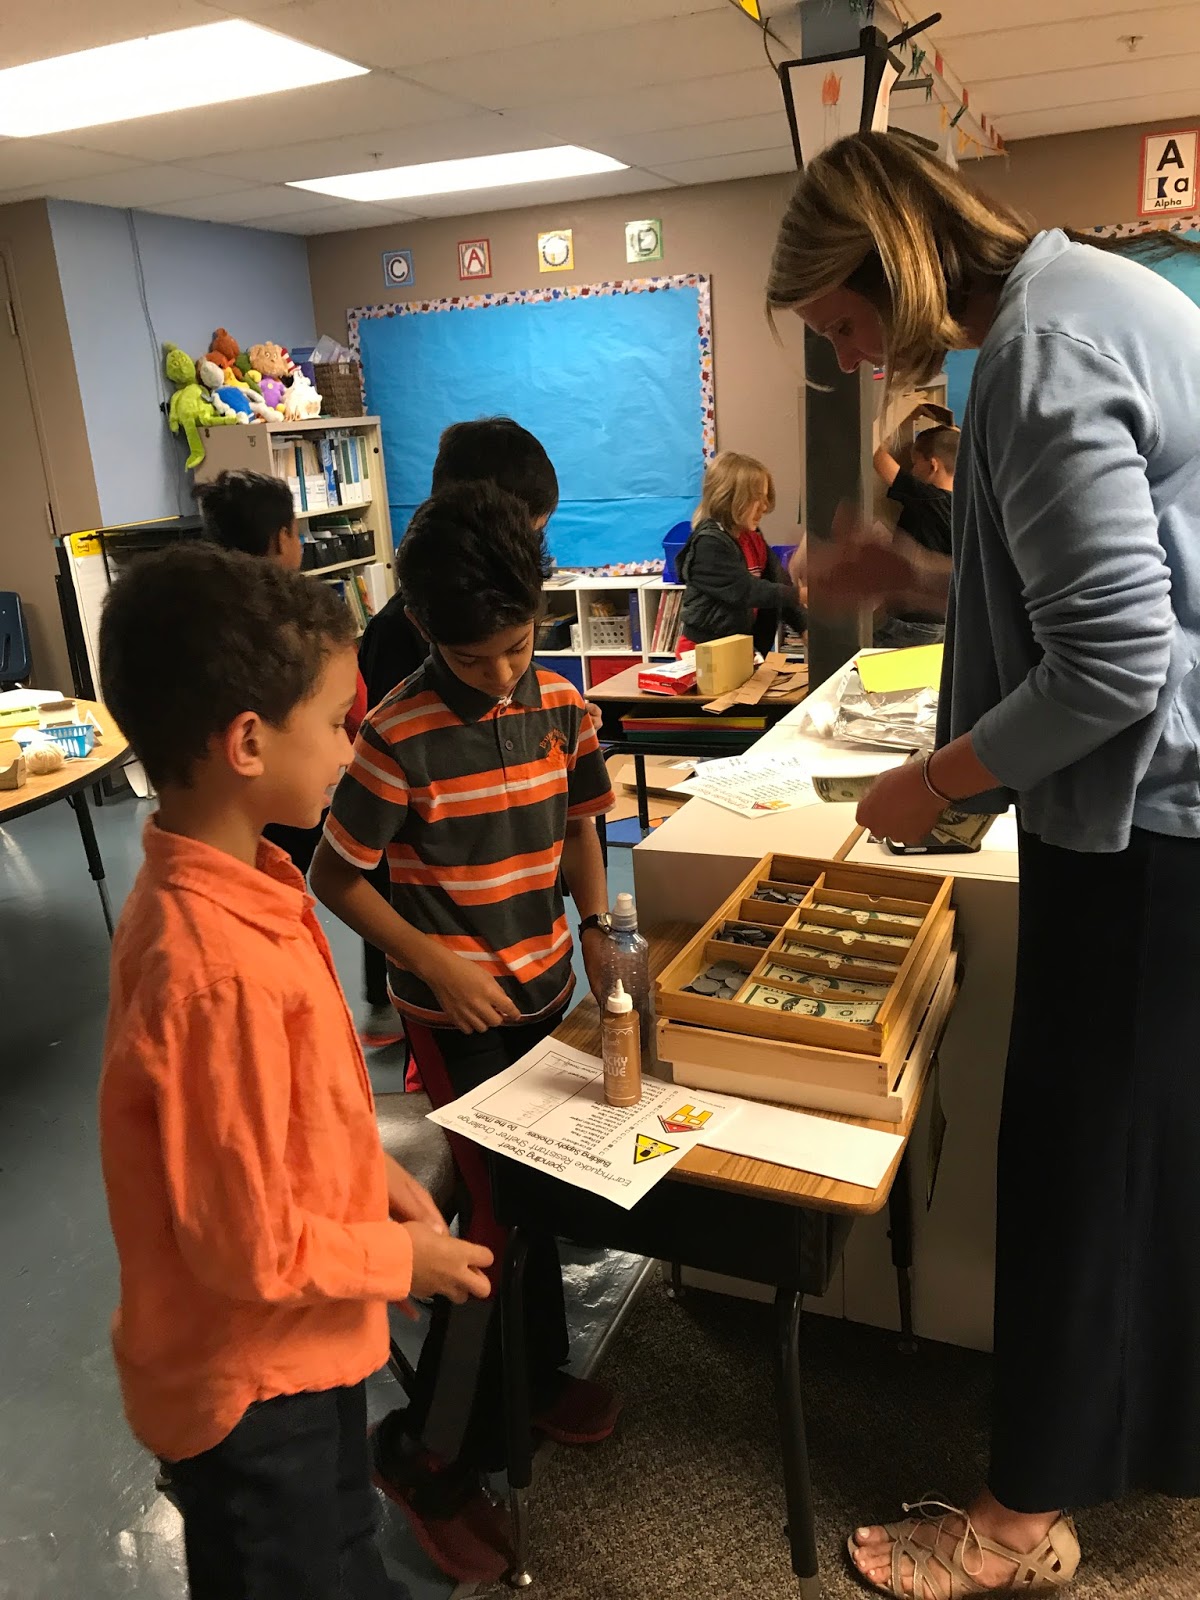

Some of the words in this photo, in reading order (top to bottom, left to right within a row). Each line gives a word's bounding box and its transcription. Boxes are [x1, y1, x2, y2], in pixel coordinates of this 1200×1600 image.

[1156, 139, 1184, 171] A
[1174, 177, 1189, 192] a
[1154, 199, 1182, 209] Alpha
[467, 248, 483, 270] A
[390, 258, 406, 279] C
[457, 1115, 495, 1134] Challenge
[494, 1119, 506, 1127] the
[496, 1131, 528, 1147] Shelter
[497, 1142, 525, 1156] Sheet
[529, 1144, 573, 1165] Resistant
[555, 1142, 580, 1155] Supply
[526, 1152, 566, 1172] Spending
[581, 1151, 611, 1168] Building
[575, 1161, 632, 1187] Earthquake
